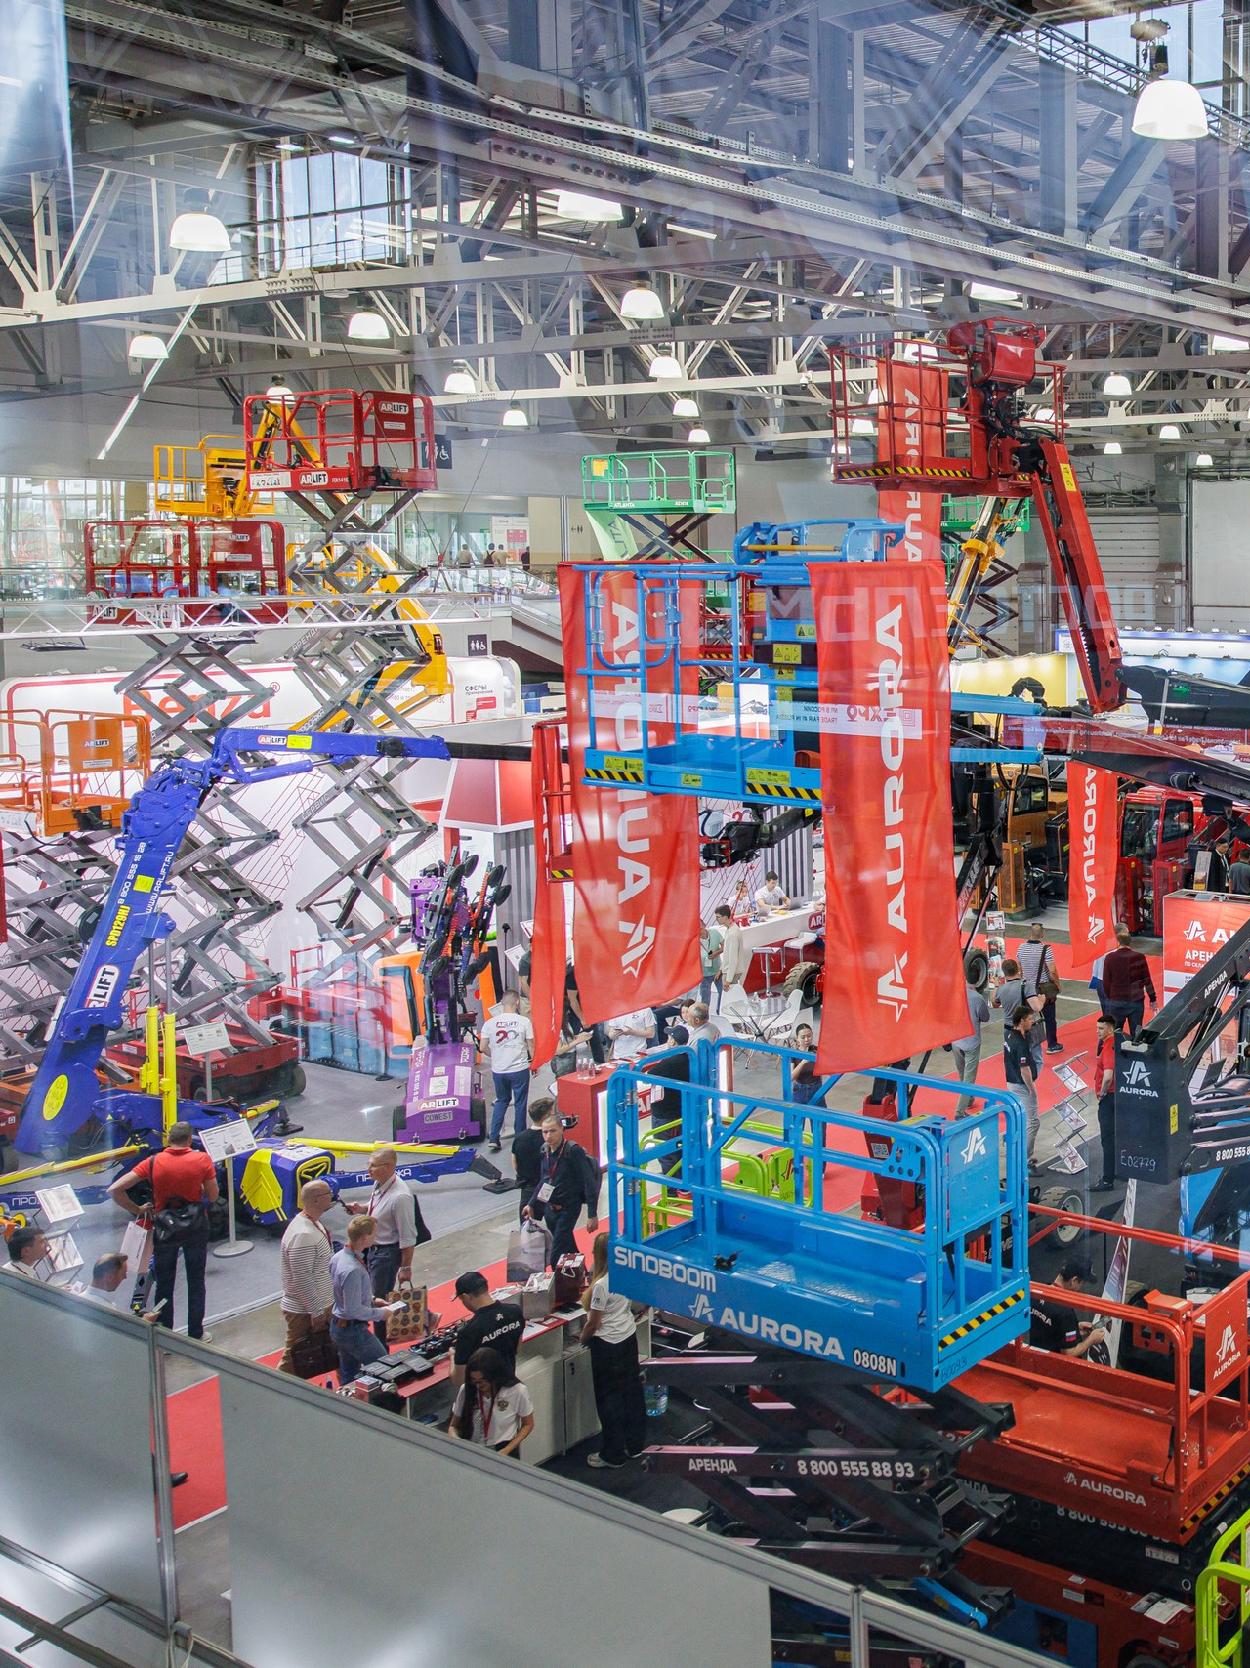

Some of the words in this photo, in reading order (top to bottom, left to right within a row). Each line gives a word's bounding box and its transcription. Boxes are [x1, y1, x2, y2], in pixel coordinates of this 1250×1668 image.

[380, 402, 408, 414] ARLIFT
[300, 473, 328, 485] ARLIFT
[875, 603, 909, 934] AURORA
[88, 966, 118, 1008] RLIFT
[1203, 970, 1228, 999] АРЕНДА
[1119, 1086, 1159, 1098] AURORA
[1215, 1150, 1221, 1161] 8
[1221, 1148, 1233, 1161] 800
[1233, 1147, 1246, 1158] 555
[613, 1246, 716, 1292] SINOBOOM
[1030, 1307, 1052, 1326] URORA
[481, 1320, 521, 1345] AURORA
[720, 1307, 845, 1360] AURORA
[853, 1348, 897, 1377] 0808N
[687, 1457, 737, 1473] АРЕНДА
[796, 1459, 807, 1475] 8
[809, 1459, 838, 1476] 800
[840, 1460, 870, 1477] 555
[871, 1461, 893, 1477] 88
[893, 1461, 915, 1478] 93
[1080, 1478, 1147, 1507] AURORA
